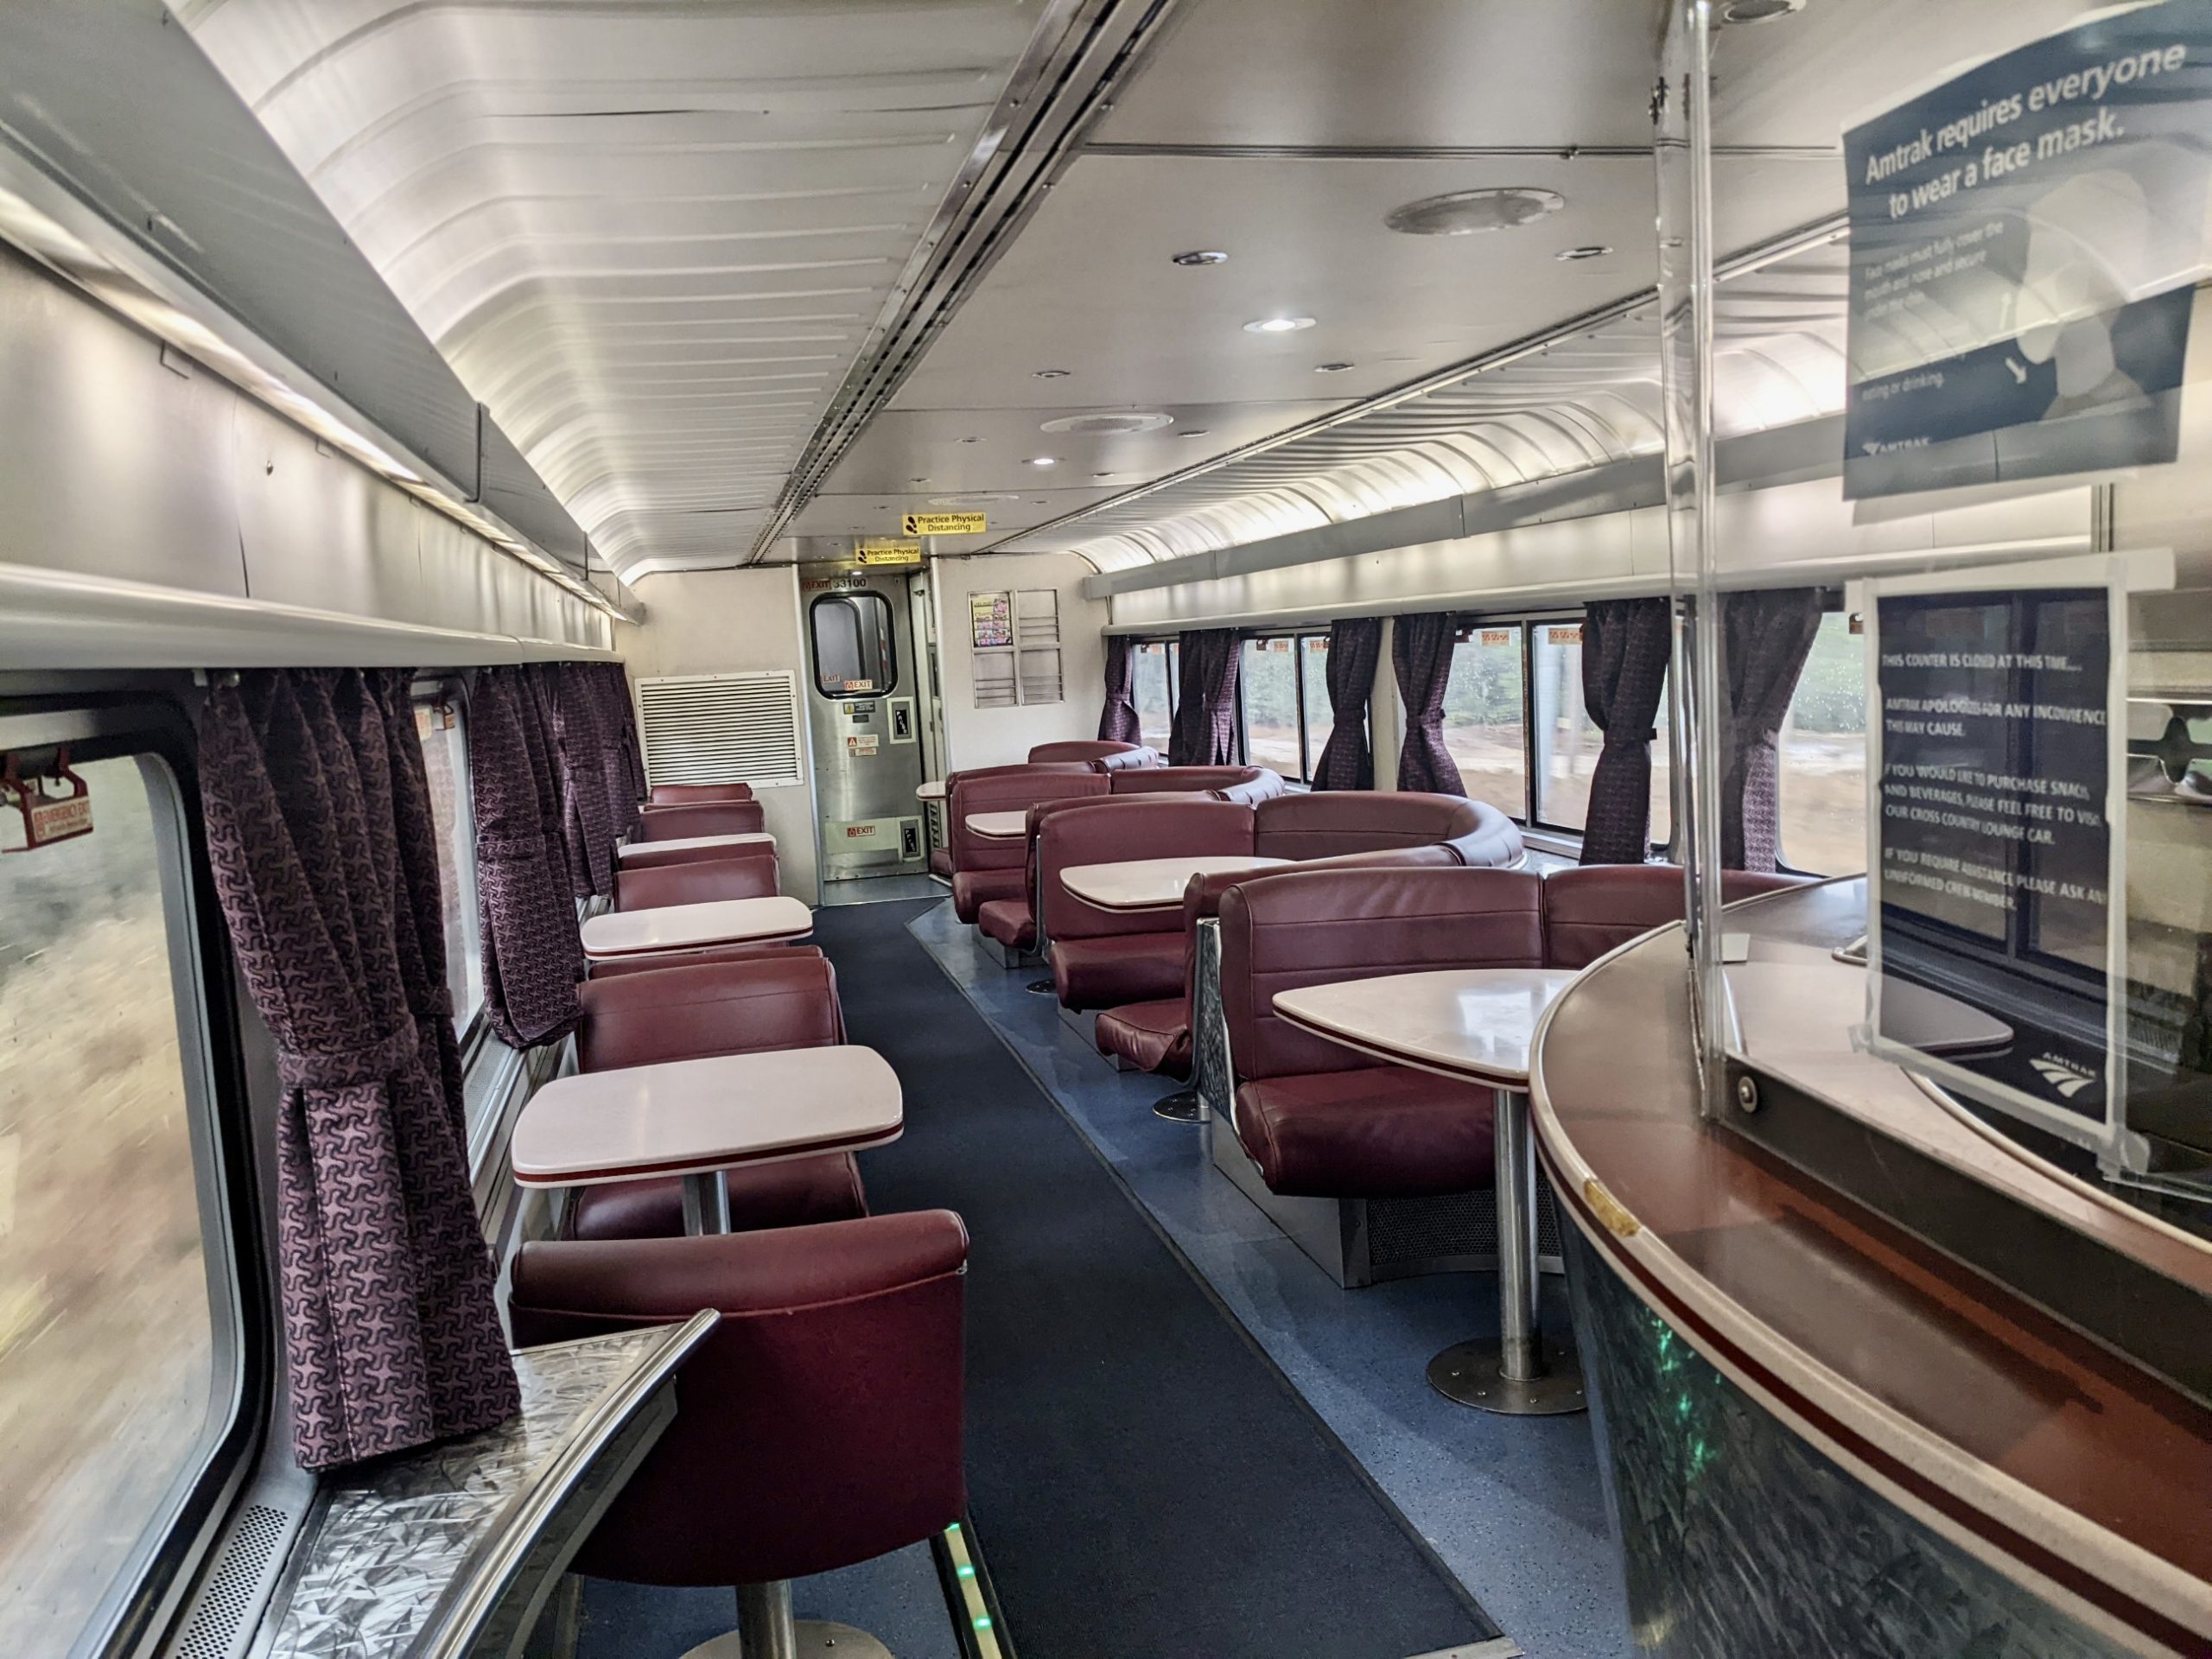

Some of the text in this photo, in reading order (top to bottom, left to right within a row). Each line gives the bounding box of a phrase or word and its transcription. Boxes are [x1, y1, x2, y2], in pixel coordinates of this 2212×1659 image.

[1866, 43, 2187, 185] Amtrak requires everyone
[1888, 105, 2125, 220] to wear a face mask.
[918, 513, 984, 524] Practice Physical
[927, 523, 971, 532] Distancing
[893, 548, 919, 556] Physical
[811, 580, 830, 588] EXIT
[833, 578, 867, 589] 33100
[1905, 654, 1948, 668] COUNTER
[1948, 654, 1961, 668] IS
[1997, 655, 2013, 669] AT
[2016, 654, 2044, 670] THIS
[823, 674, 840, 683] EXIT
[854, 680, 872, 689] EXIT
[2004, 702, 2031, 719] ANY
[1892, 765, 1916, 778] YOU
[1916, 765, 1955, 782] WOULD
[1986, 773, 2048, 795] PURCHASE
[1885, 784, 1908, 797] AND
[1997, 798, 2023, 816] FEEL
[2024, 803, 2053, 821] FREE
[2056, 807, 2075, 823] TO
[856, 826, 874, 836] EXIT
[1885, 804, 1909, 818] OUR
[1910, 806, 1941, 824] CROSS
[1980, 820, 2025, 841] LOUNGE
[2026, 828, 2056, 846] CAR.
[1884, 868, 1945, 891] UNIFORMED
[1895, 849, 1919, 864] YOU
[1919, 852, 1960, 873] REQUIRE
[2015, 874, 2056, 896] PLEASE
[2059, 882, 2085, 900] ASK
[2043, 1052, 2096, 1077] AMTRAK
